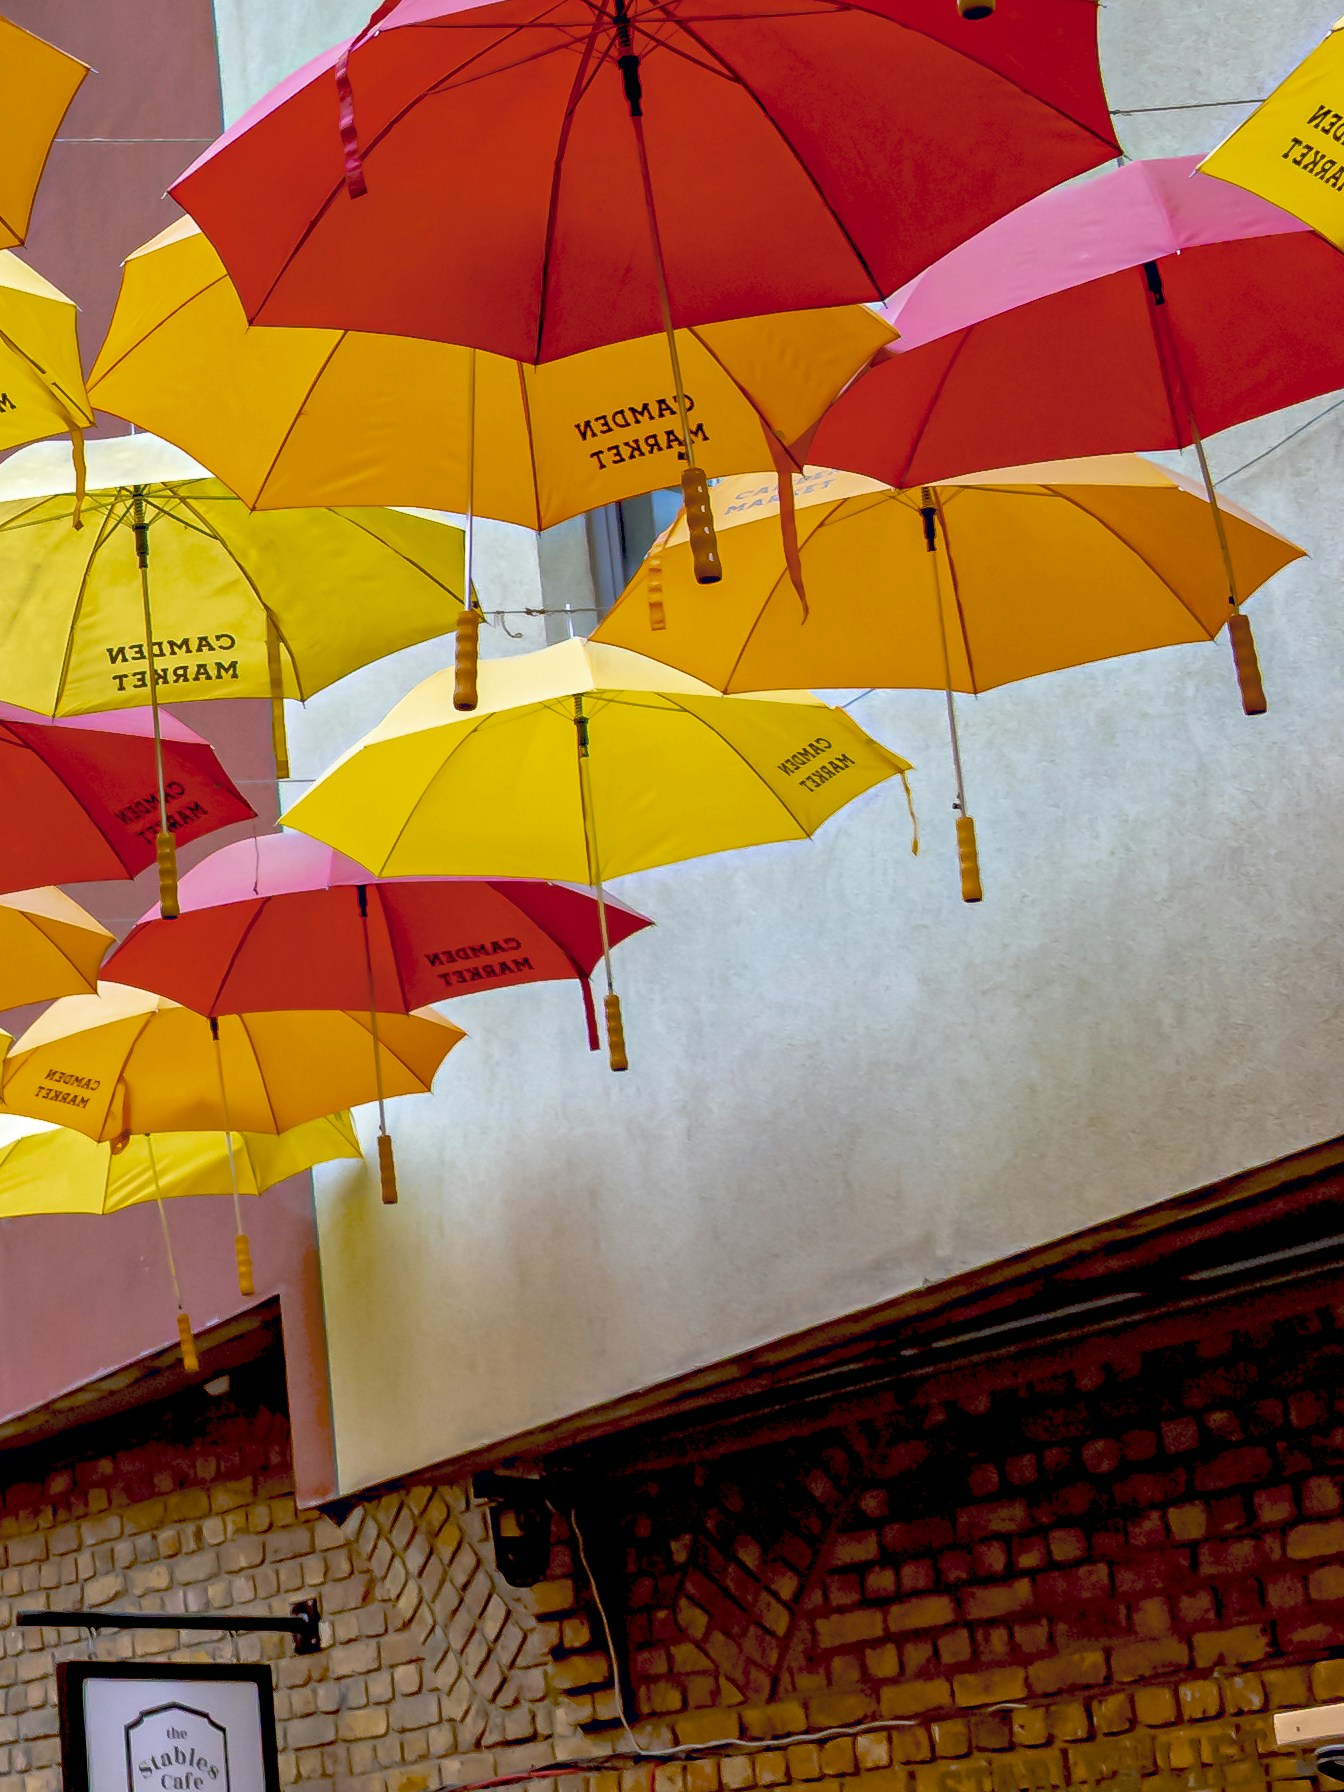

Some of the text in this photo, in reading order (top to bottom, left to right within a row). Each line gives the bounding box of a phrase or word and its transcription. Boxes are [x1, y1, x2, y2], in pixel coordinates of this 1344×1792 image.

[723, 479, 836, 515] MARET
[735, 469, 841, 500] CADEN
[166, 1726, 188, 1740] the
[138, 1745, 220, 1780] Stables
[160, 1772, 204, 1791] Cafe
